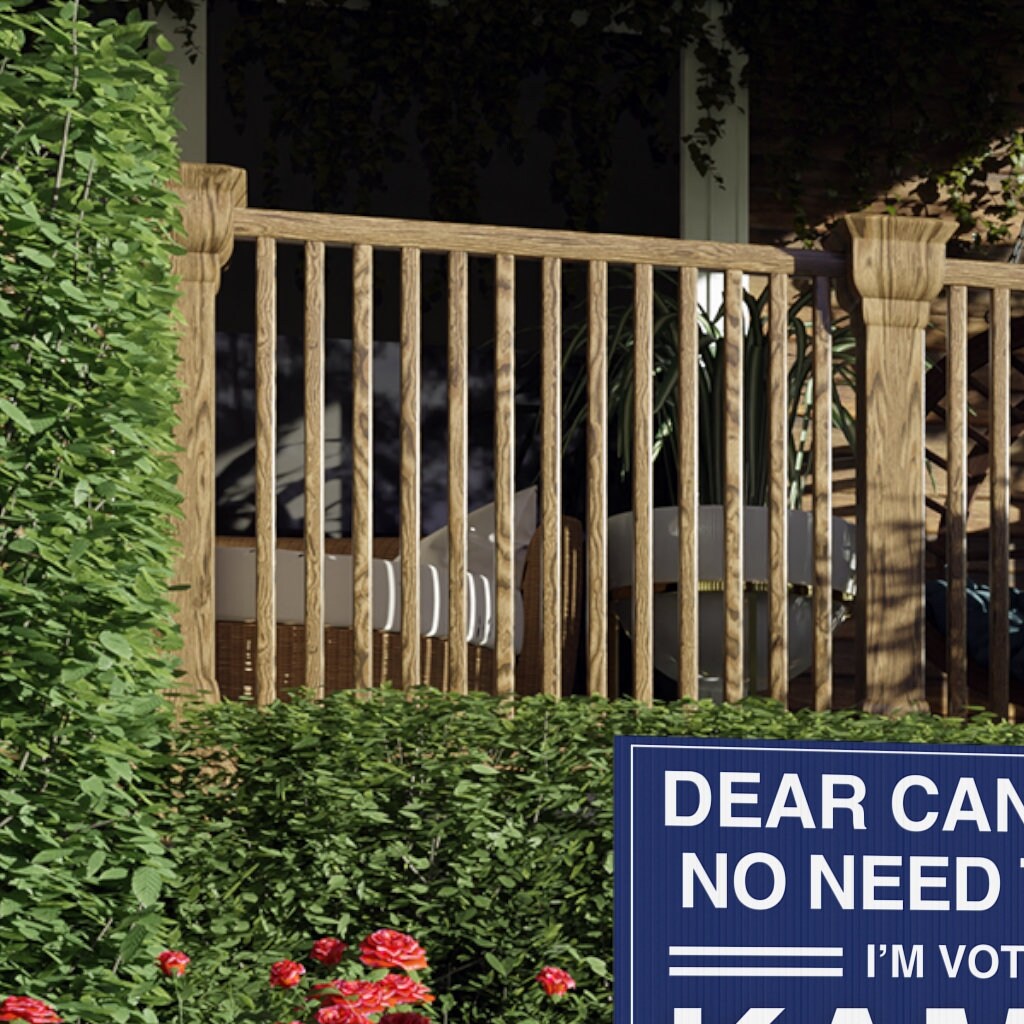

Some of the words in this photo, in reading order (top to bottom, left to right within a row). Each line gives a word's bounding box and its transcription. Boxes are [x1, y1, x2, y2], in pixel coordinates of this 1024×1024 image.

[664, 770, 867, 831] DEAR
[682, 851, 786, 911] NO
[810, 854, 1001, 911] NEED
[867, 943, 924, 978] I'M
